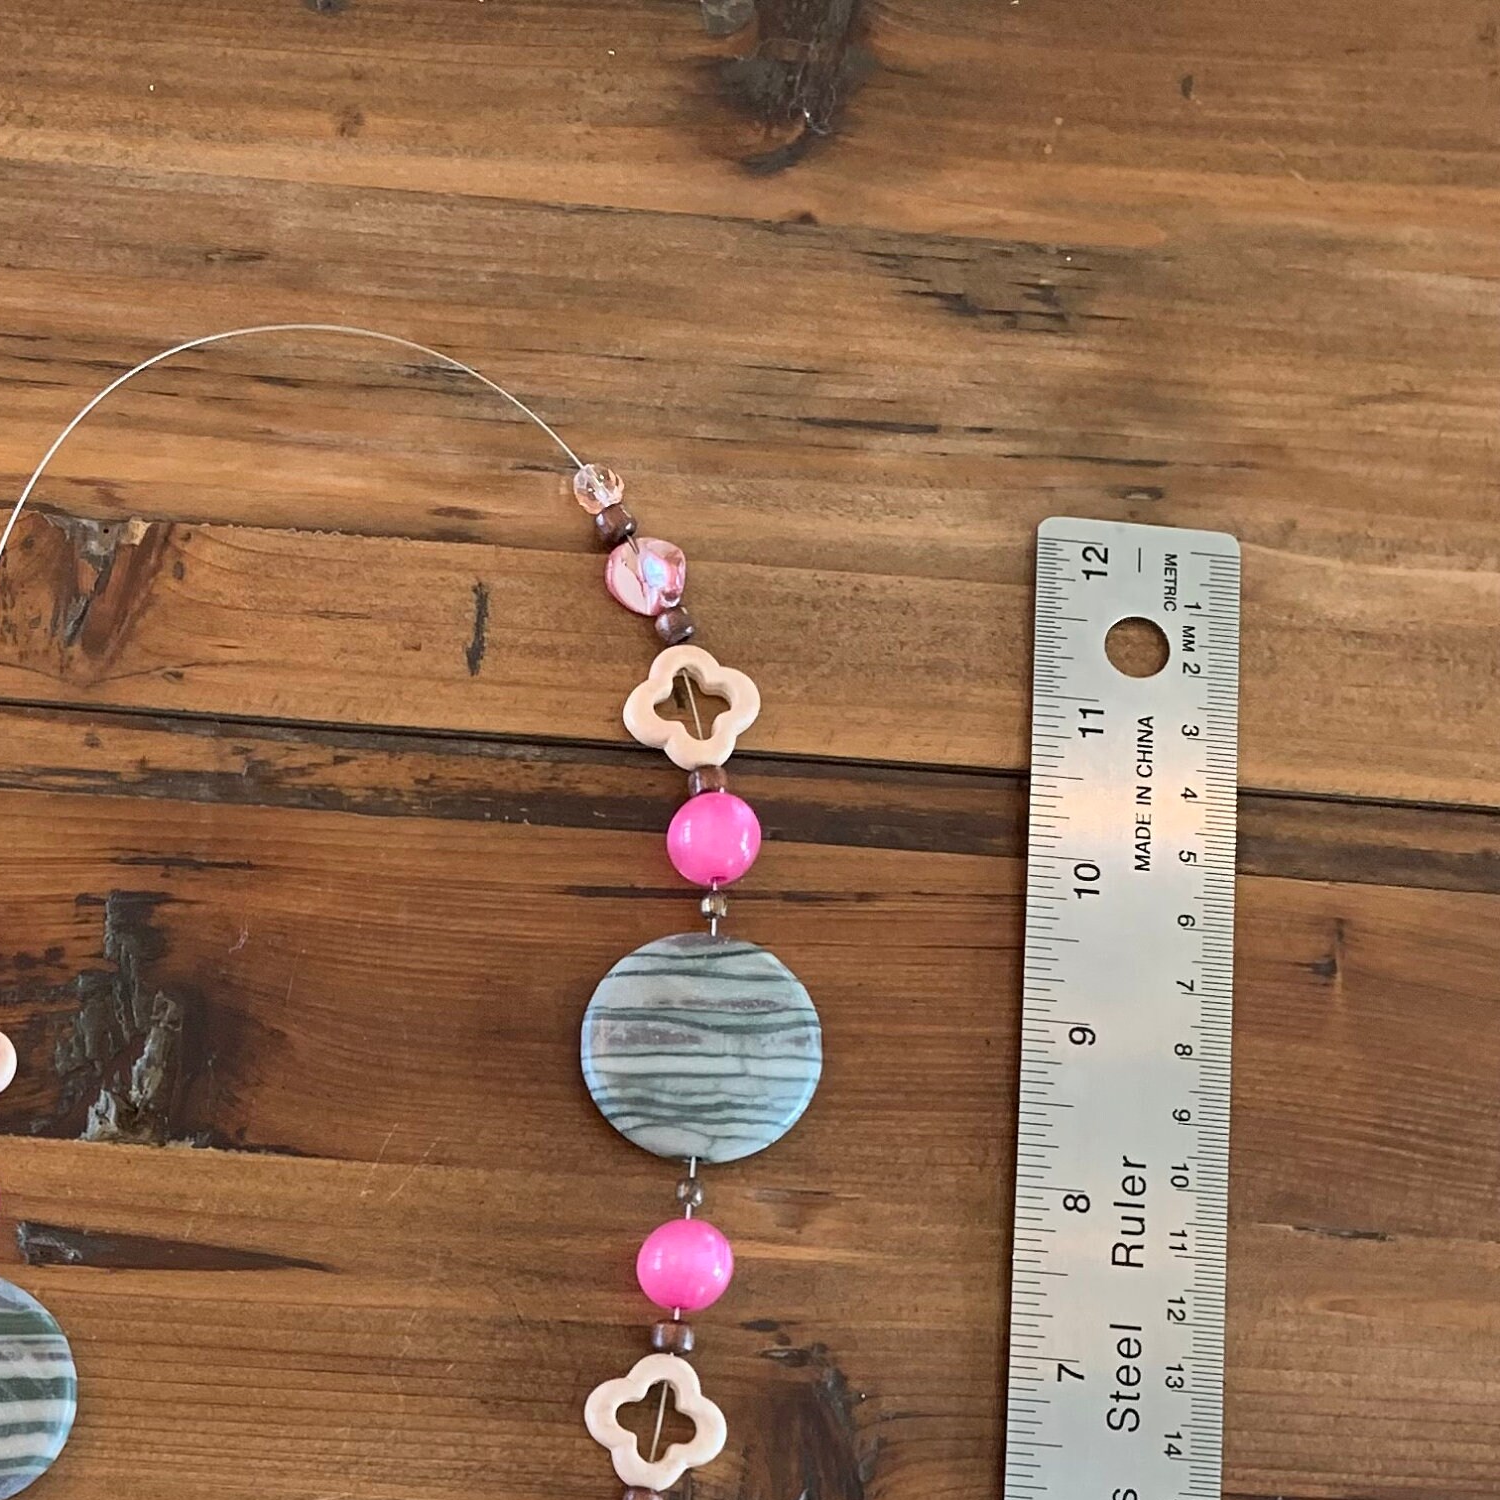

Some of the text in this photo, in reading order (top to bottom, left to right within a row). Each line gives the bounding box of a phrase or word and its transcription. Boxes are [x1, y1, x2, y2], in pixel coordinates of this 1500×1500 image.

[1082, 546, 1109, 580] 12
[1164, 553, 1177, 612] METRIC
[1183, 601, 1202, 612] 1
[1182, 624, 1196, 653] MM
[1182, 662, 1200, 674] 2
[1078, 707, 1104, 738] 11
[1181, 725, 1199, 737] 3
[1134, 716, 1154, 872] MADE IN CHINA
[1180, 787, 1197, 800] 4
[1178, 850, 1196, 863] 5
[1073, 862, 1100, 899] 10
[1177, 914, 1195, 927] 6
[1176, 980, 1193, 992] 7
[1068, 1025, 1096, 1046] 9
[1174, 1044, 1193, 1056] 8
[1172, 1109, 1190, 1122] 9
[1170, 1163, 1189, 1188] 10
[1063, 1194, 1091, 1213] 8
[1111, 1155, 1147, 1268] Ruler
[1168, 1230, 1187, 1252] 11
[1167, 1297, 1185, 1321] 12
[1057, 1363, 1085, 1382] 7
[1106, 1324, 1142, 1432] Steel
[1165, 1364, 1183, 1389] 13
[1164, 1432, 1182, 1457] 14
